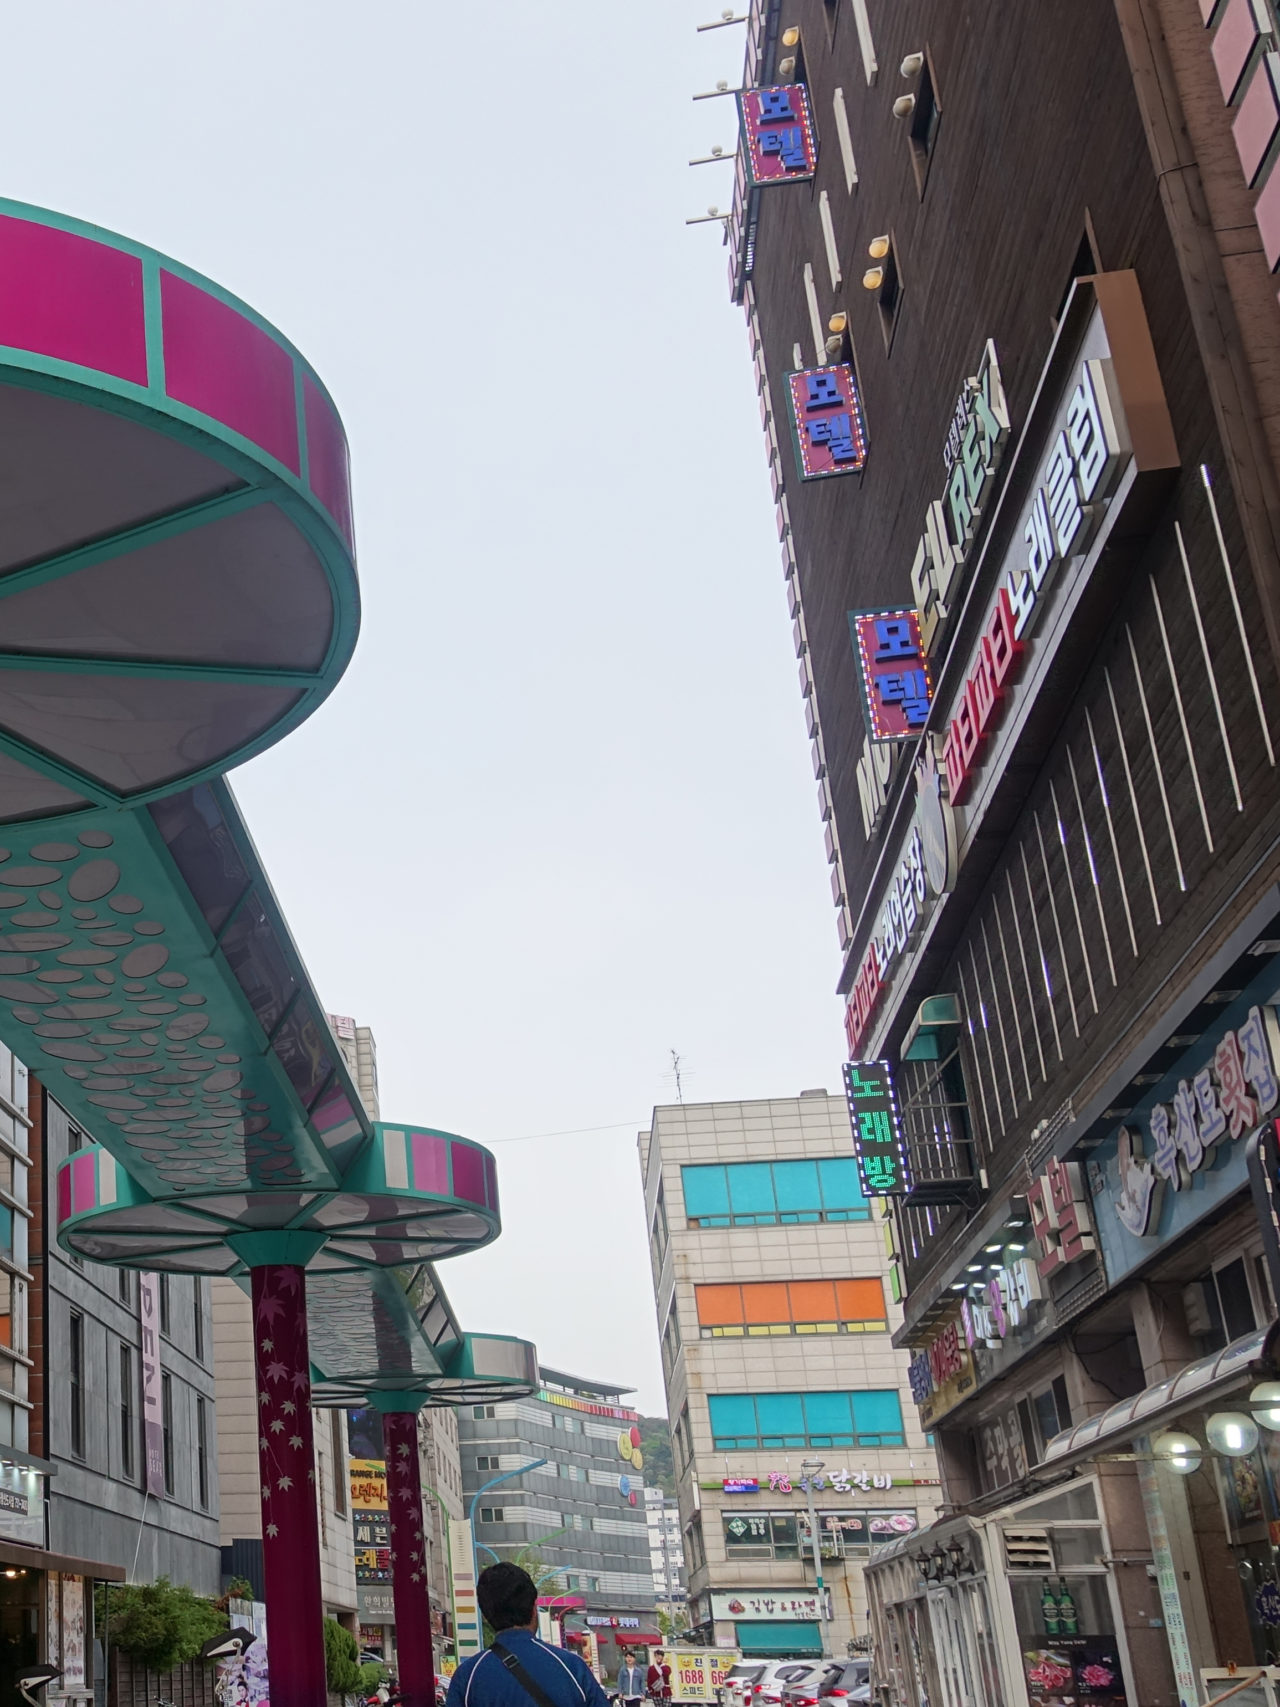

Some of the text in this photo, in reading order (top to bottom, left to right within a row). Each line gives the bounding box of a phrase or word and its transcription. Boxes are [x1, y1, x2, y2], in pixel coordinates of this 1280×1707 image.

[756, 90, 808, 173] 모텔
[804, 371, 857, 465] 모텔
[949, 362, 1009, 550] REX
[873, 619, 930, 728] 모텔
[850, 1067, 896, 1190] 노래방
[141, 1271, 157, 1406] PEN
[350, 1469, 374, 1479] RANGE
[826, 1467, 893, 1497] 닭갈비
[357, 1525, 388, 1544] 세븐
[749, 1598, 776, 1614] 김밥
[790, 1598, 816, 1613] 라면
[679, 1669, 705, 1685] 1688
[682, 1686, 705, 1696] 스피드
